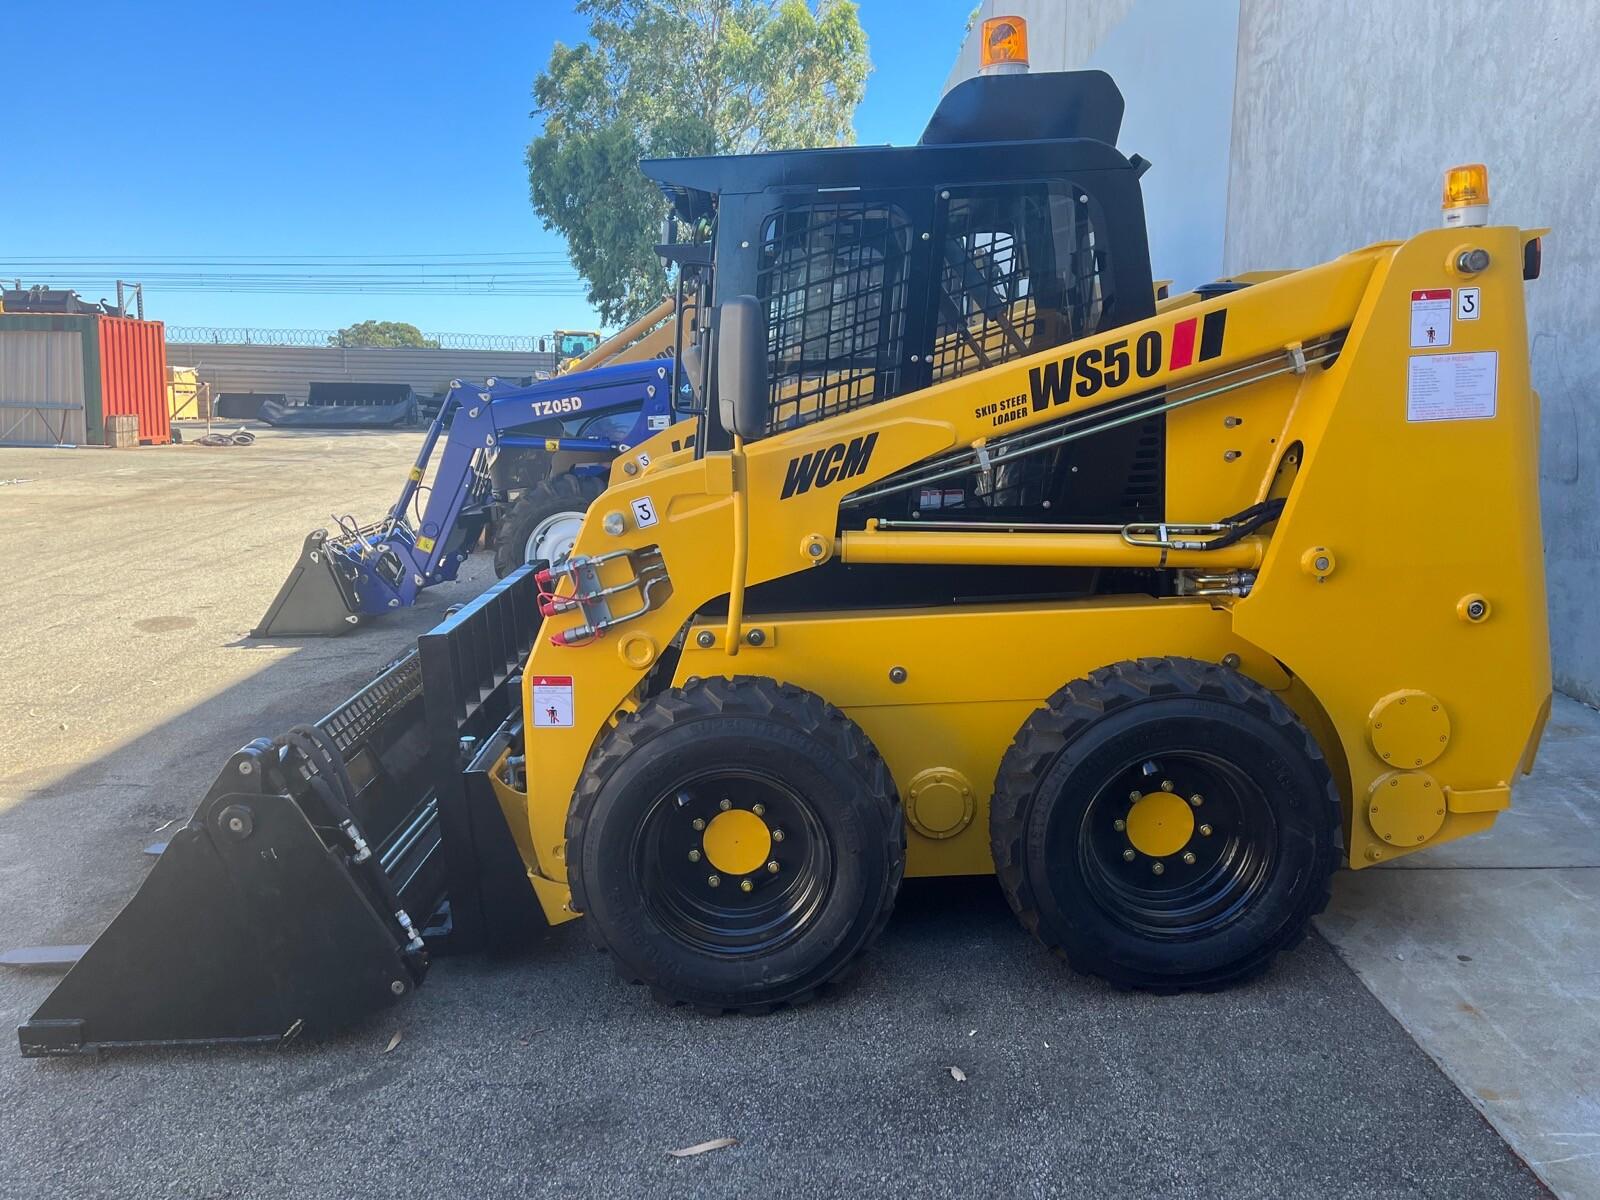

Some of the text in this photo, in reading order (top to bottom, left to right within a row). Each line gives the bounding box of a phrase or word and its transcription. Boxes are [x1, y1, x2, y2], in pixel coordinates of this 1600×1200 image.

[1029, 331, 1162, 412] WS50
[531, 396, 582, 416] TZ05D
[975, 394, 1027, 418] SKID STEER
[993, 407, 1028, 426] LOADER
[780, 431, 880, 500] WCM
